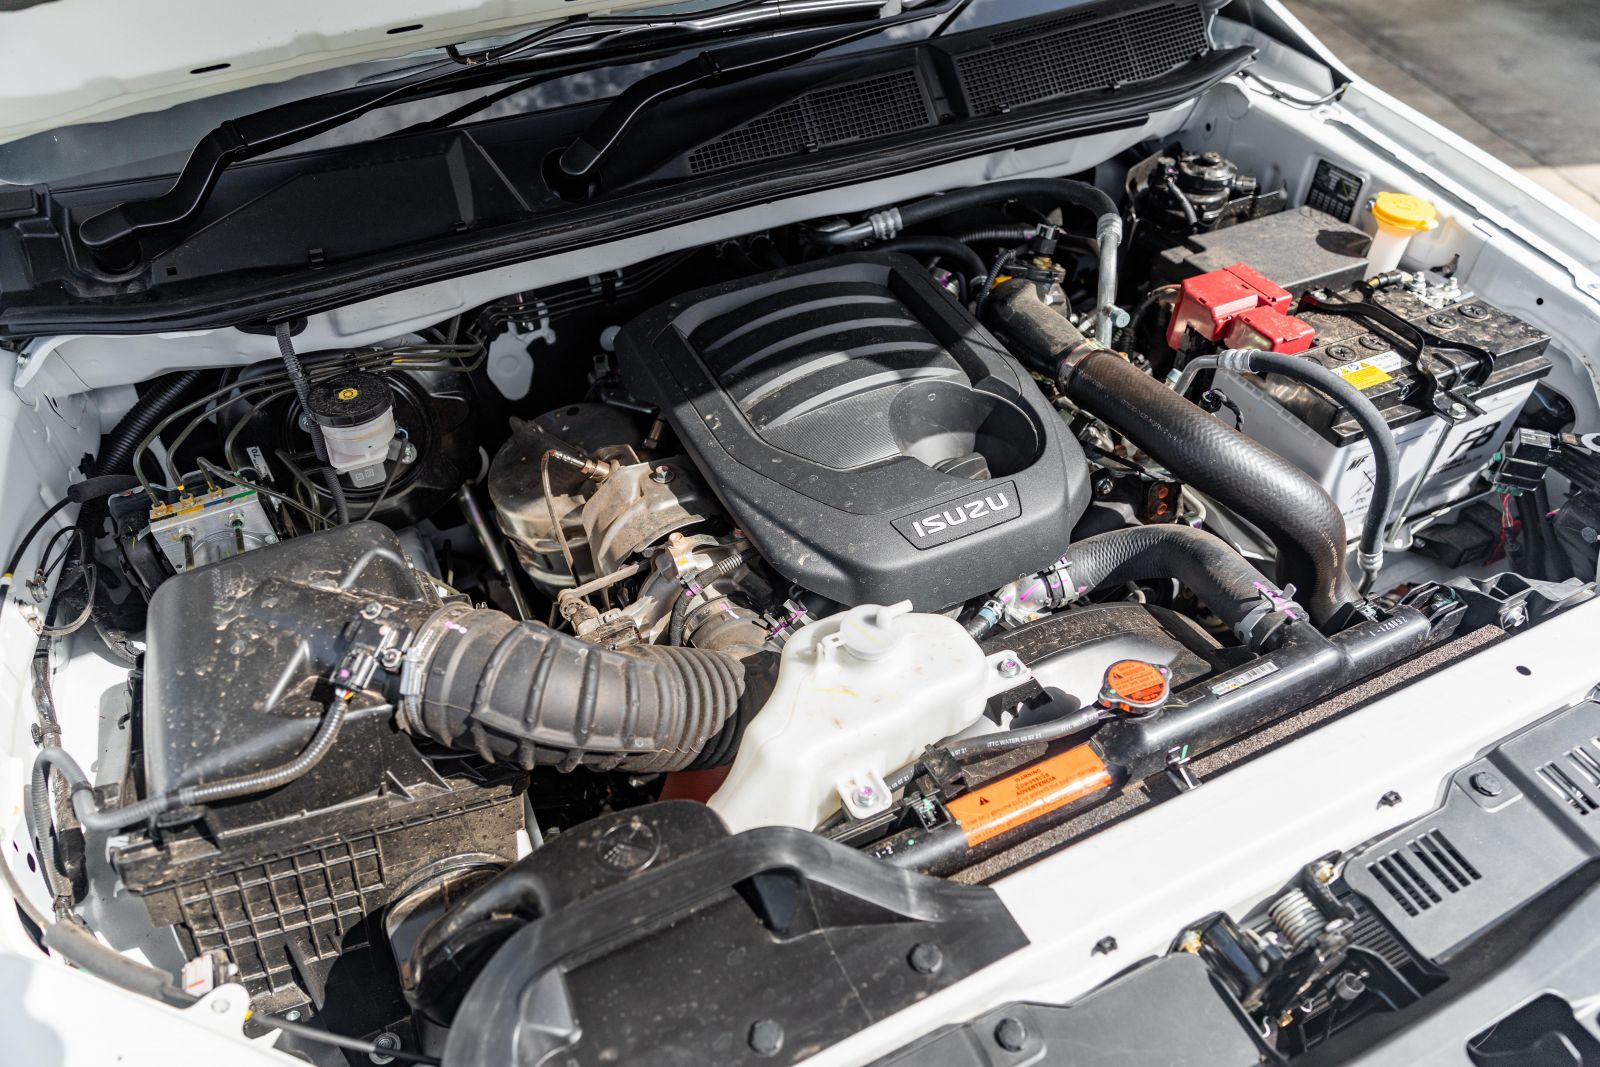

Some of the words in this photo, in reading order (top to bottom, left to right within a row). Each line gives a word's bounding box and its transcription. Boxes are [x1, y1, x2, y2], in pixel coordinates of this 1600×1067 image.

[912, 492, 1009, 538] ISUZU
[1000, 736, 1020, 746] WATER
[1014, 768, 1041, 783] WARNING
[1016, 775, 1056, 796] ADVERTENCIA
